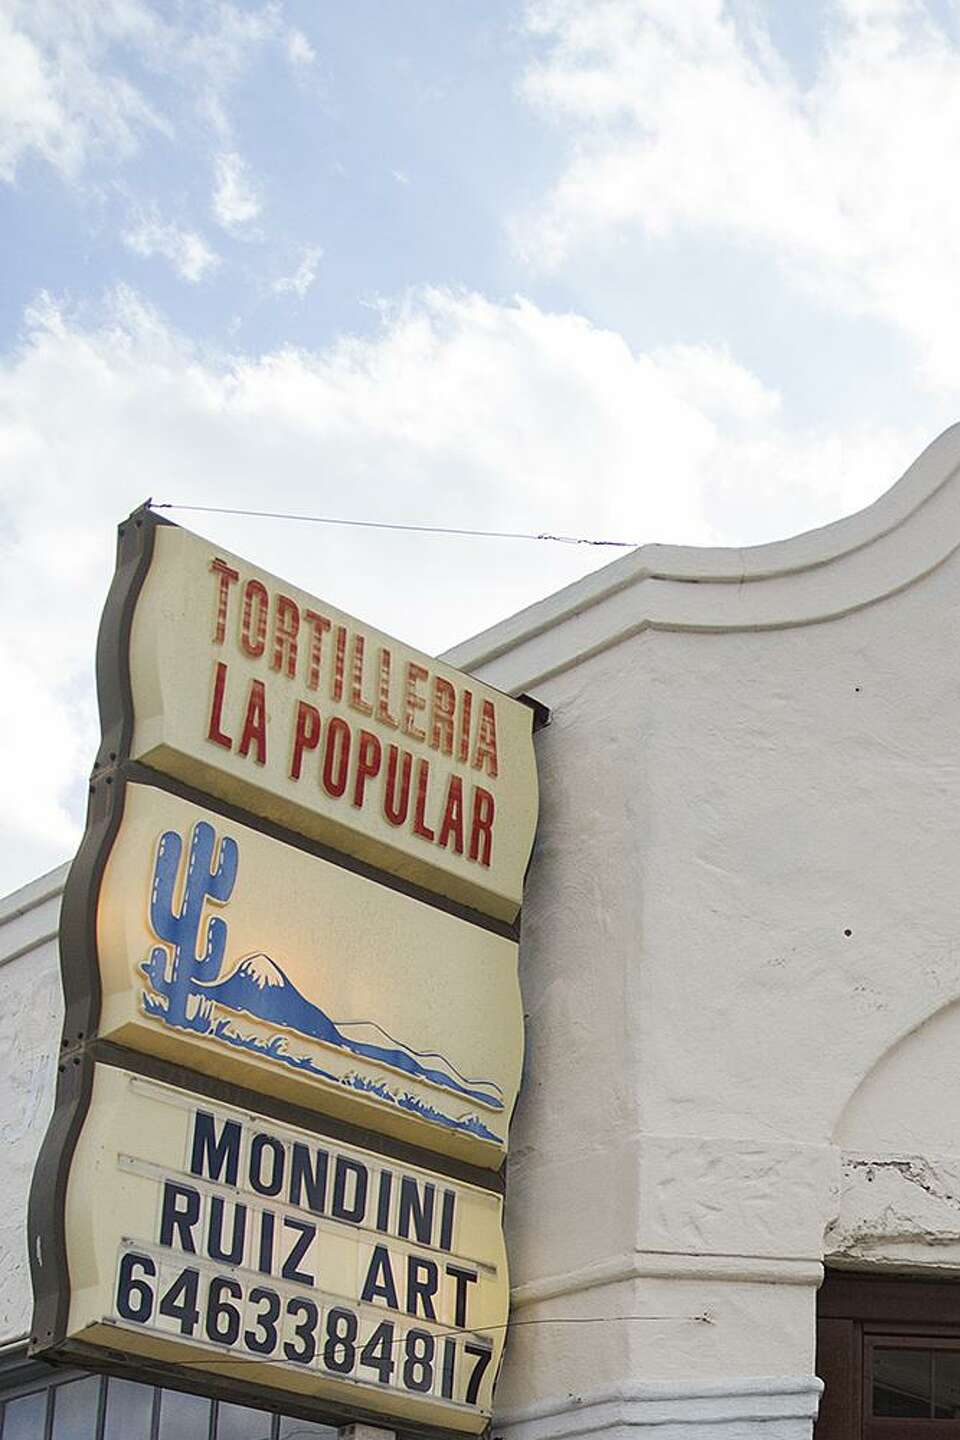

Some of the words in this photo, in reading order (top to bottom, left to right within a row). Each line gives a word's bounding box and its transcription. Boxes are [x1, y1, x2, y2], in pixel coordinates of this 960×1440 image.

[210, 557, 500, 779] TORTILLERIA
[208, 661, 267, 767] LA
[289, 699, 497, 868] POPULAR
[159, 1181, 317, 1287] RUIZ
[360, 1244, 479, 1329] ART
[190, 1109, 457, 1252] MONDINI
[116, 1251, 493, 1405] 6463384817
